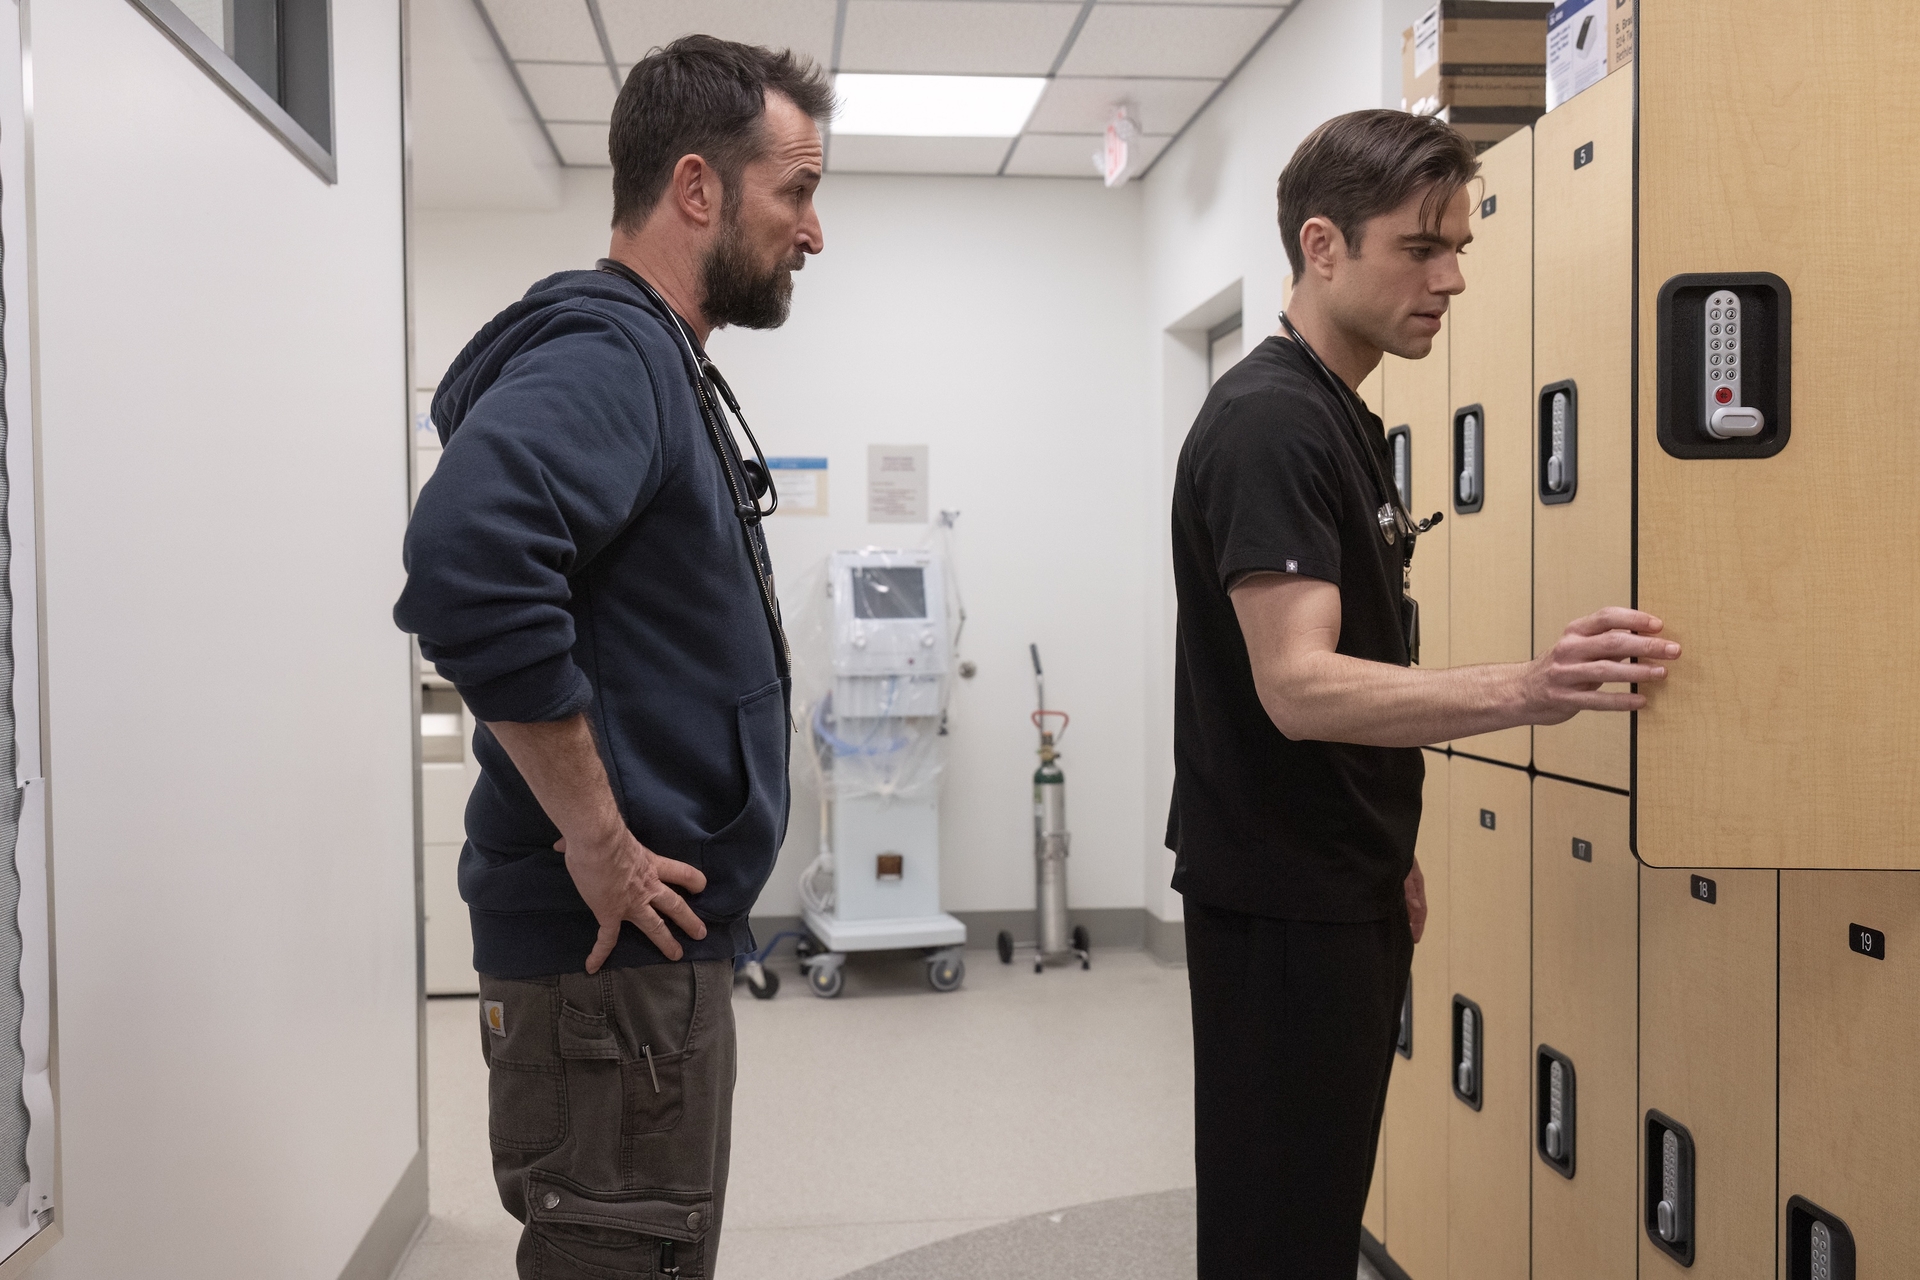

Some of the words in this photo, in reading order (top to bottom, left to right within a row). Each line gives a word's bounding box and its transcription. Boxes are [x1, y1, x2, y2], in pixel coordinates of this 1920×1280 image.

[1580, 148, 1587, 164] 5
[1578, 842, 1586, 858] 17
[1699, 881, 1708, 898] 18
[1860, 931, 1872, 952] 19
